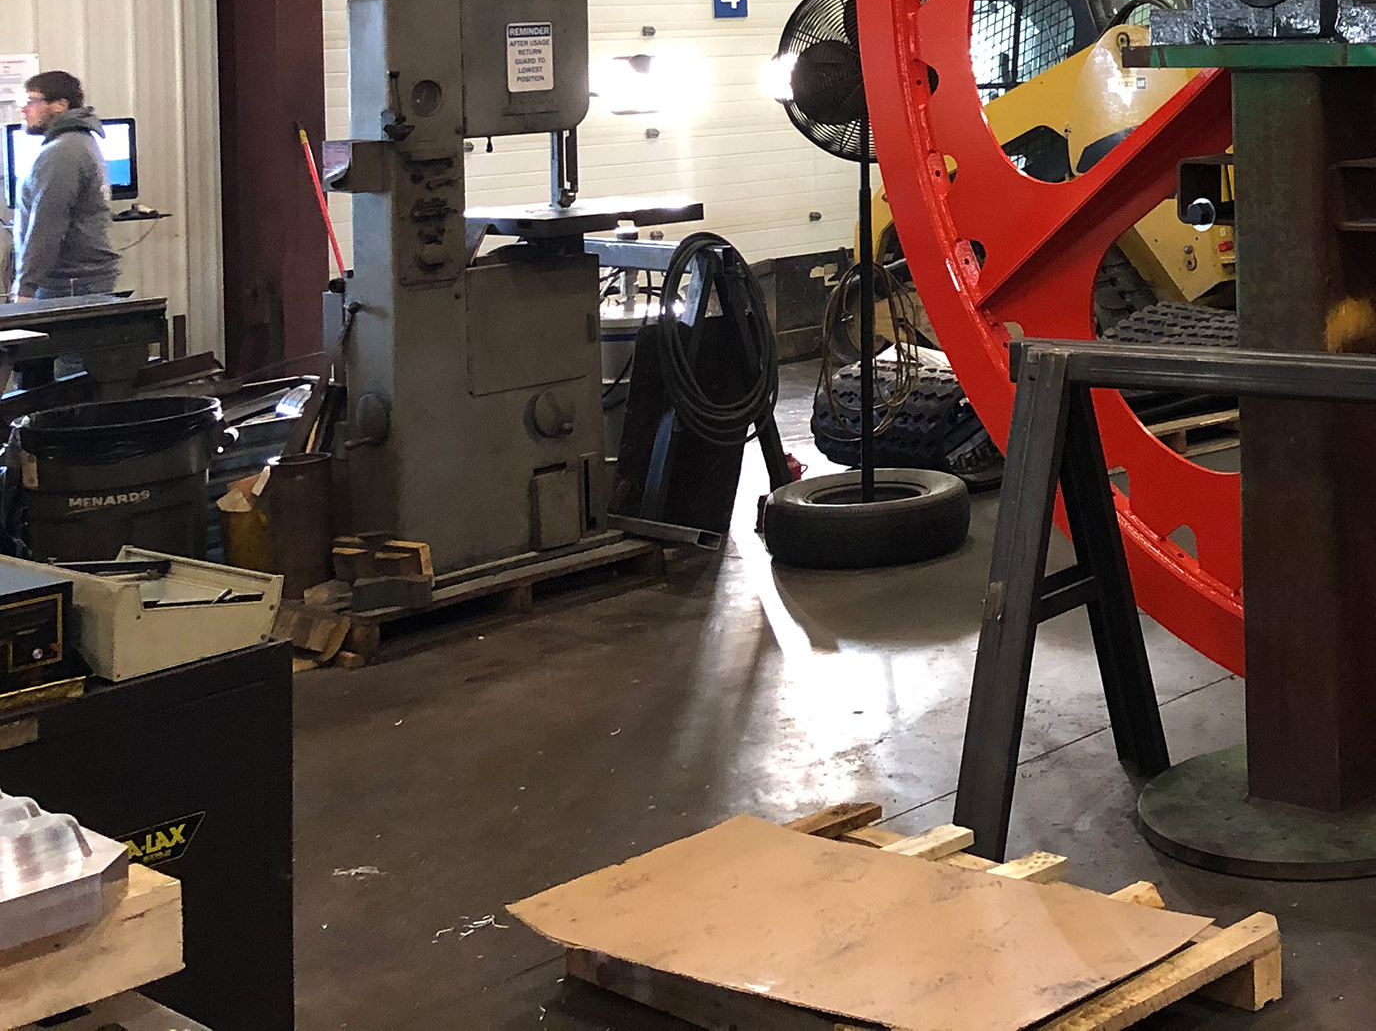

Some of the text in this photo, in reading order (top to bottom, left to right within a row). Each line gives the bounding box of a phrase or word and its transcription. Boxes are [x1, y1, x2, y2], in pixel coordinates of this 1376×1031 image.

[509, 27, 550, 36] REMINDER
[538, 56, 546, 64] TO
[518, 66, 543, 74] LOWEST
[516, 75, 545, 83] POSITION
[68, 489, 151, 508] MENARDS
